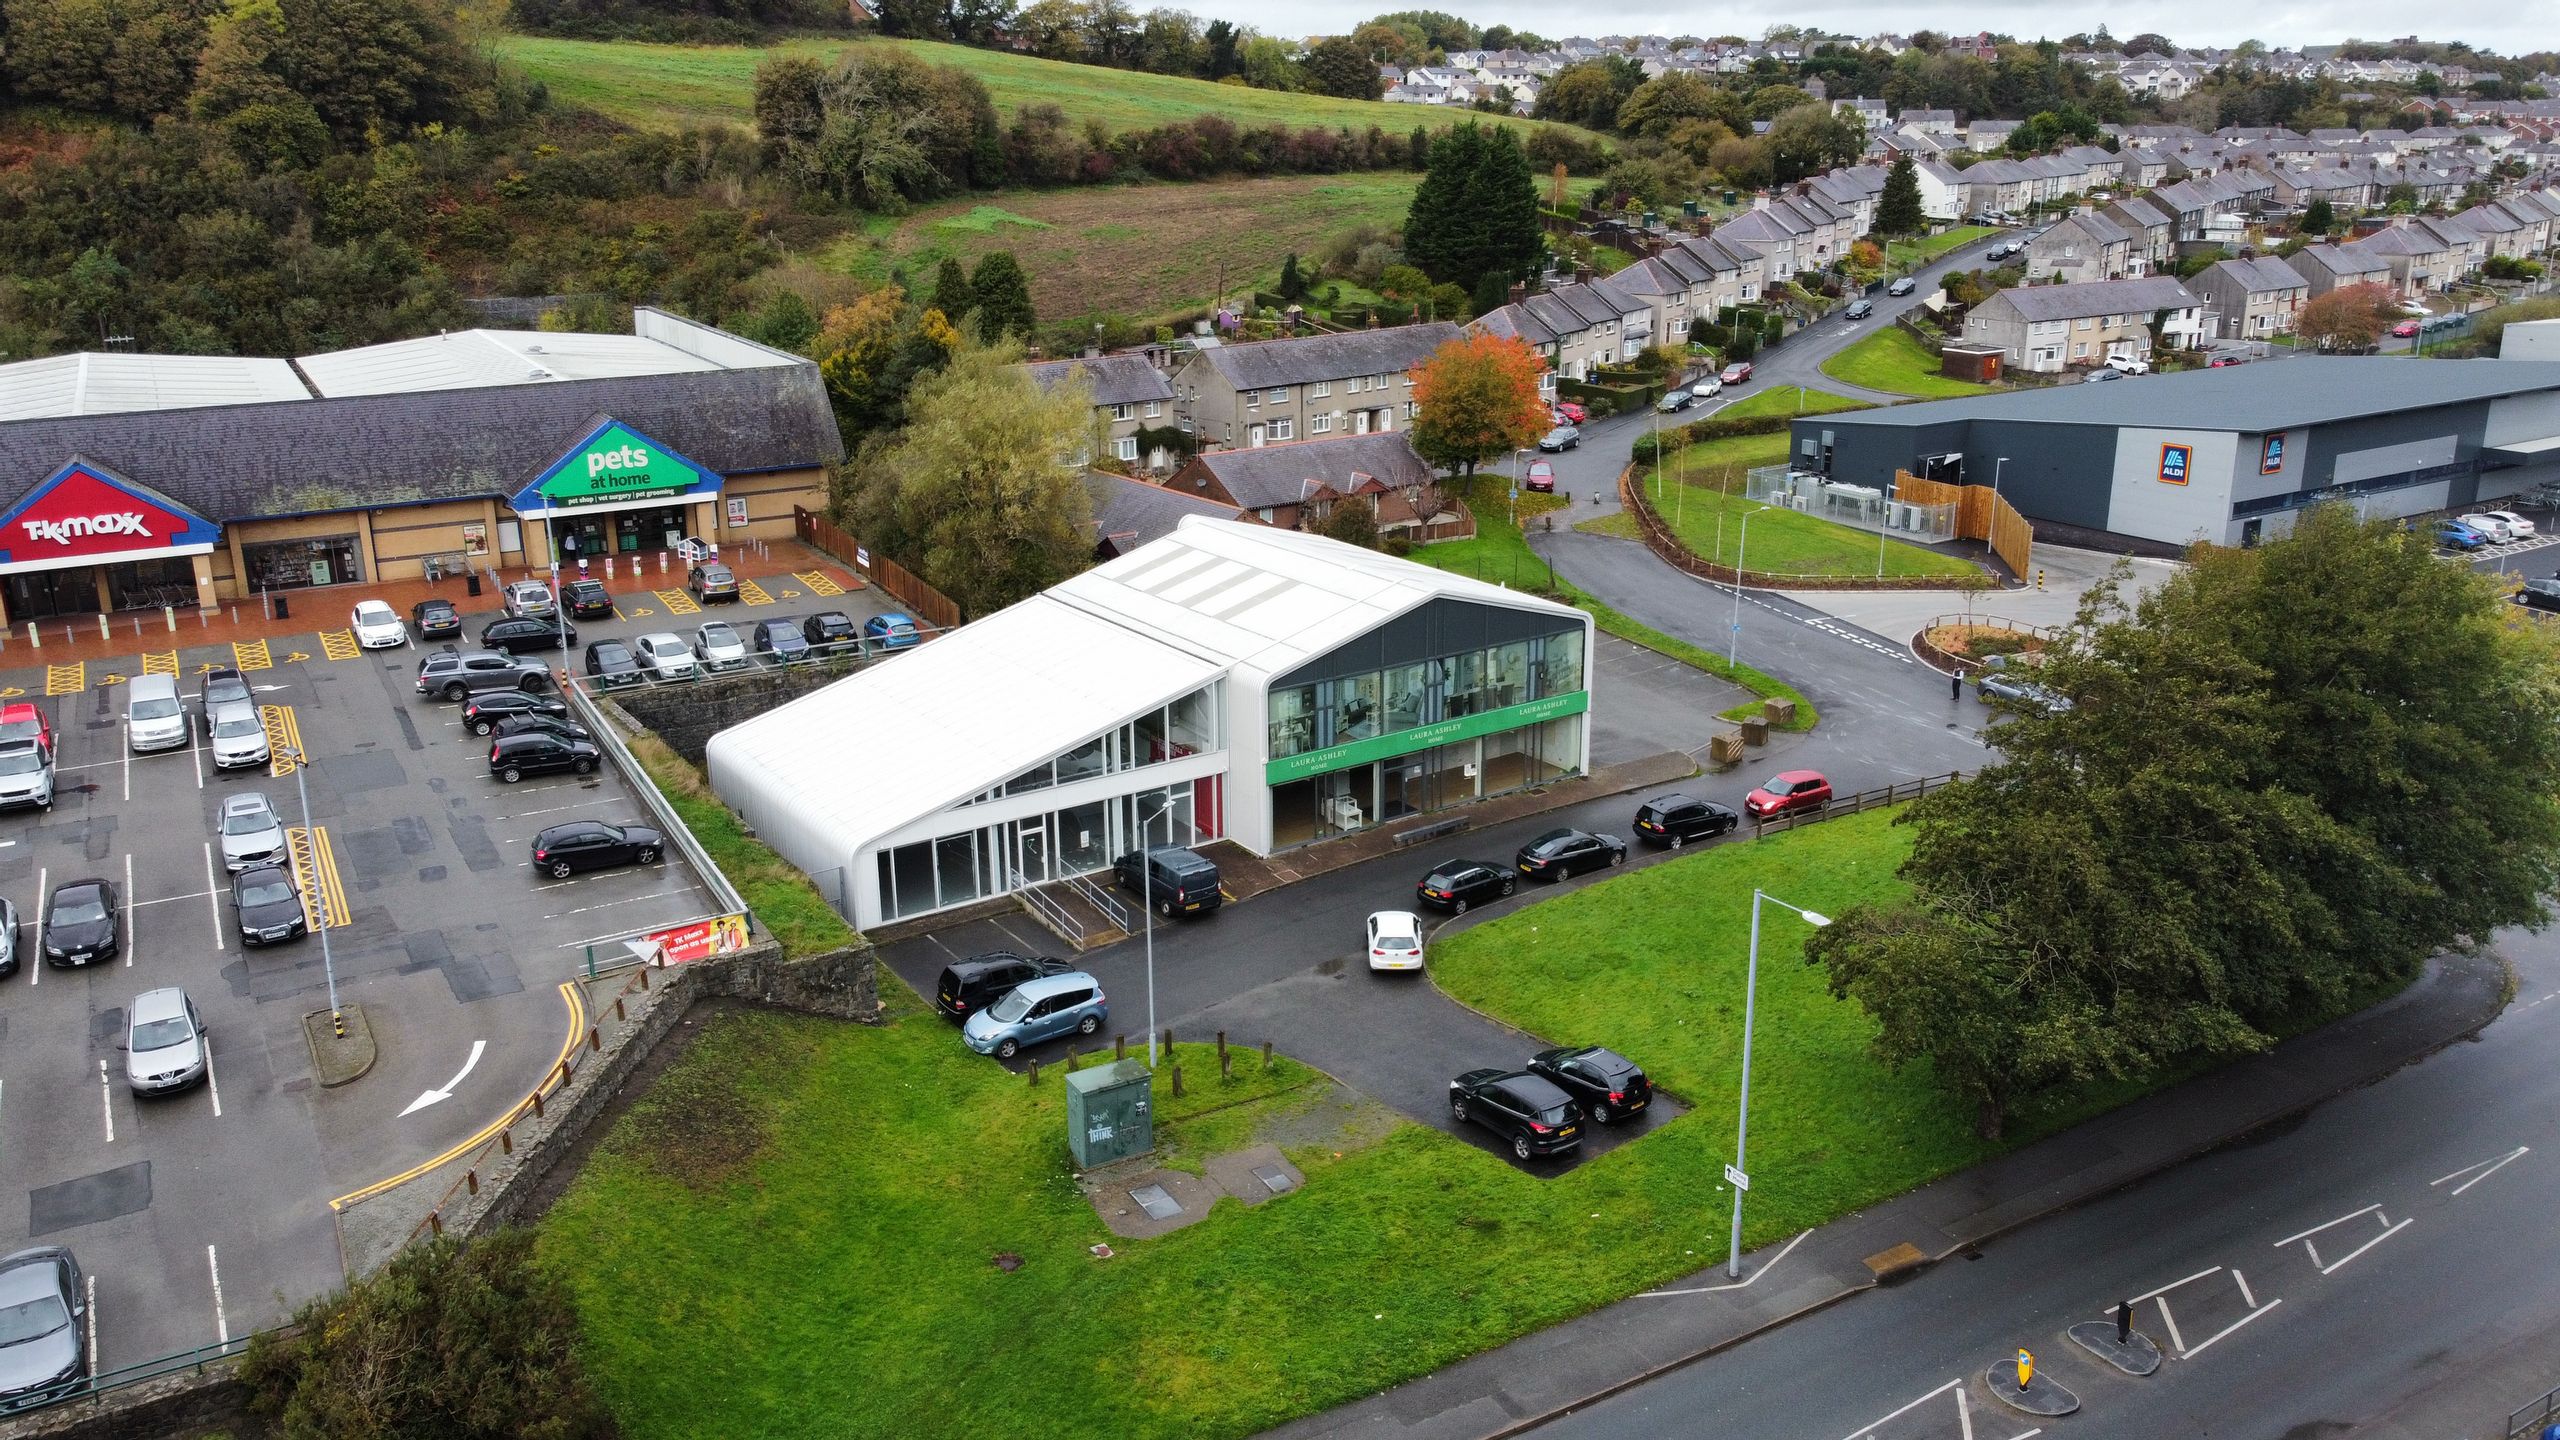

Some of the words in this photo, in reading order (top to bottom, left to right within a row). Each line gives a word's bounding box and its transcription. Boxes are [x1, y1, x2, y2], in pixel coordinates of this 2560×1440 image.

[587, 444, 649, 477] pets
[2266, 457, 2280, 466] ALDI
[2163, 467, 2184, 476] ALDI
[590, 477, 606, 489] at
[609, 473, 651, 488] home
[568, 498, 579, 506] pet
[579, 496, 594, 505] shop
[609, 493, 632, 502] surgery
[646, 488, 675, 498] grooming
[1519, 705, 1541, 716] LAURA
[1542, 699, 1568, 711] ASHLEY
[1410, 730, 1433, 741] LAURA
[1434, 723, 1462, 735] ASHLEY
[1291, 757, 1316, 768] LAURA
[1317, 749, 1347, 762] ASHLEY
[1311, 763, 1328, 771] HOME
[674, 937, 684, 945] TK
[684, 930, 704, 941] Maxx
